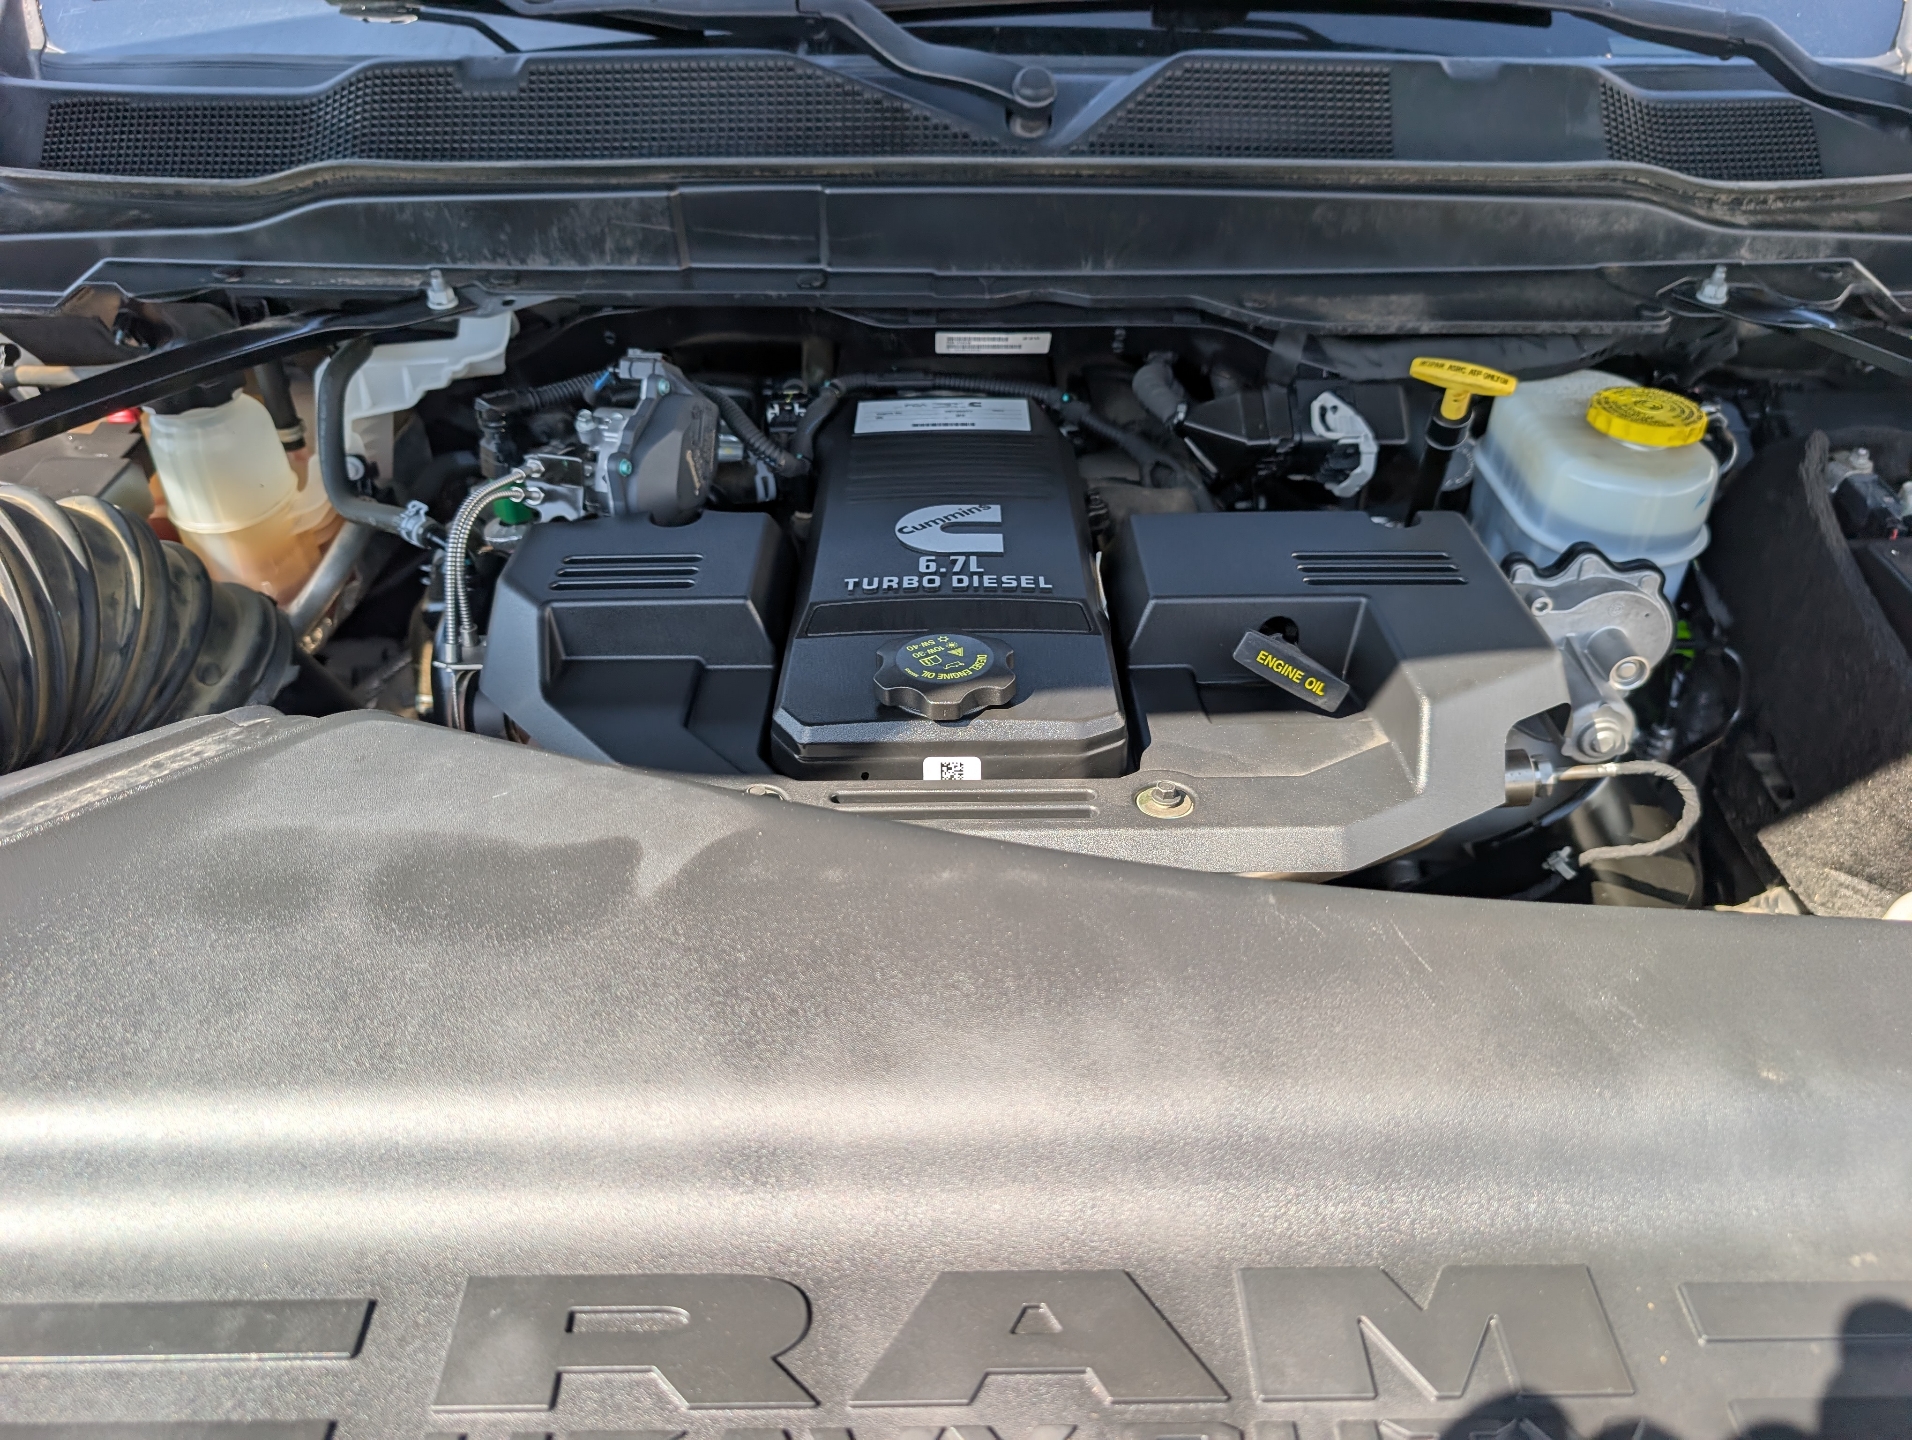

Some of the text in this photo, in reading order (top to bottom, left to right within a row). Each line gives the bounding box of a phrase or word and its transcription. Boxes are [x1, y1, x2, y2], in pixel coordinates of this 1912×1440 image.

[897, 504, 992, 535] Cummins
[918, 555, 985, 574] 6.7L
[844, 575, 1053, 593] TURBO DIESEL
[906, 639, 936, 652] 5W-40
[912, 645, 945, 659] 10W-30
[969, 654, 988, 671] DIESEL
[921, 670, 936, 679] OIL
[936, 669, 973, 680] ENGINE
[1255, 650, 1326, 696] ENGINE OIL
[429, 1264, 1636, 1410] RAM
